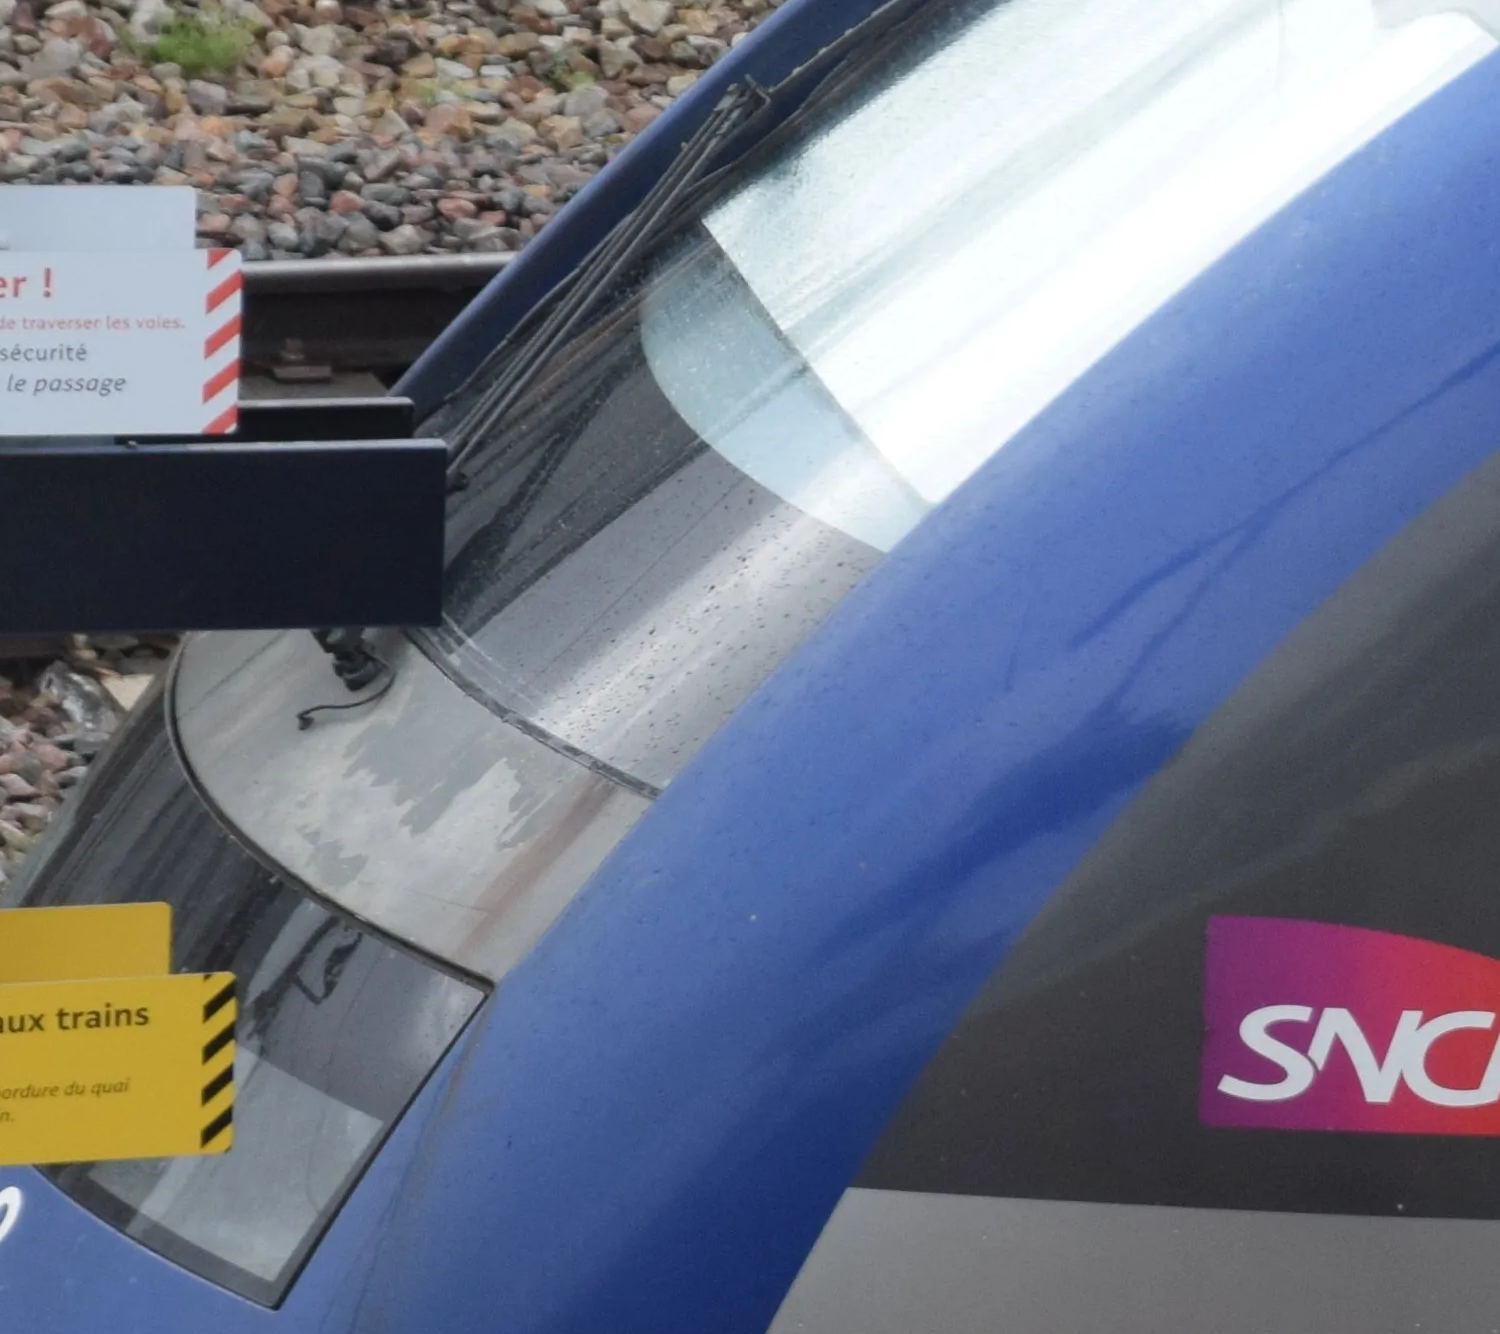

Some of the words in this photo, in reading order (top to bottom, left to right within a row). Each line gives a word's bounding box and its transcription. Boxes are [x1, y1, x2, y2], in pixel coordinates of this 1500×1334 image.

[43, 267, 53, 299] !
[22, 317, 100, 330] traverser
[106, 315, 130, 330] les
[0, 343, 88, 362] sécurité
[6, 373, 27, 393] le
[33, 376, 127, 397] passage
[56, 1002, 150, 1031] trains
[64, 1080, 86, 1097] du
[90, 1078, 131, 1099] quai
